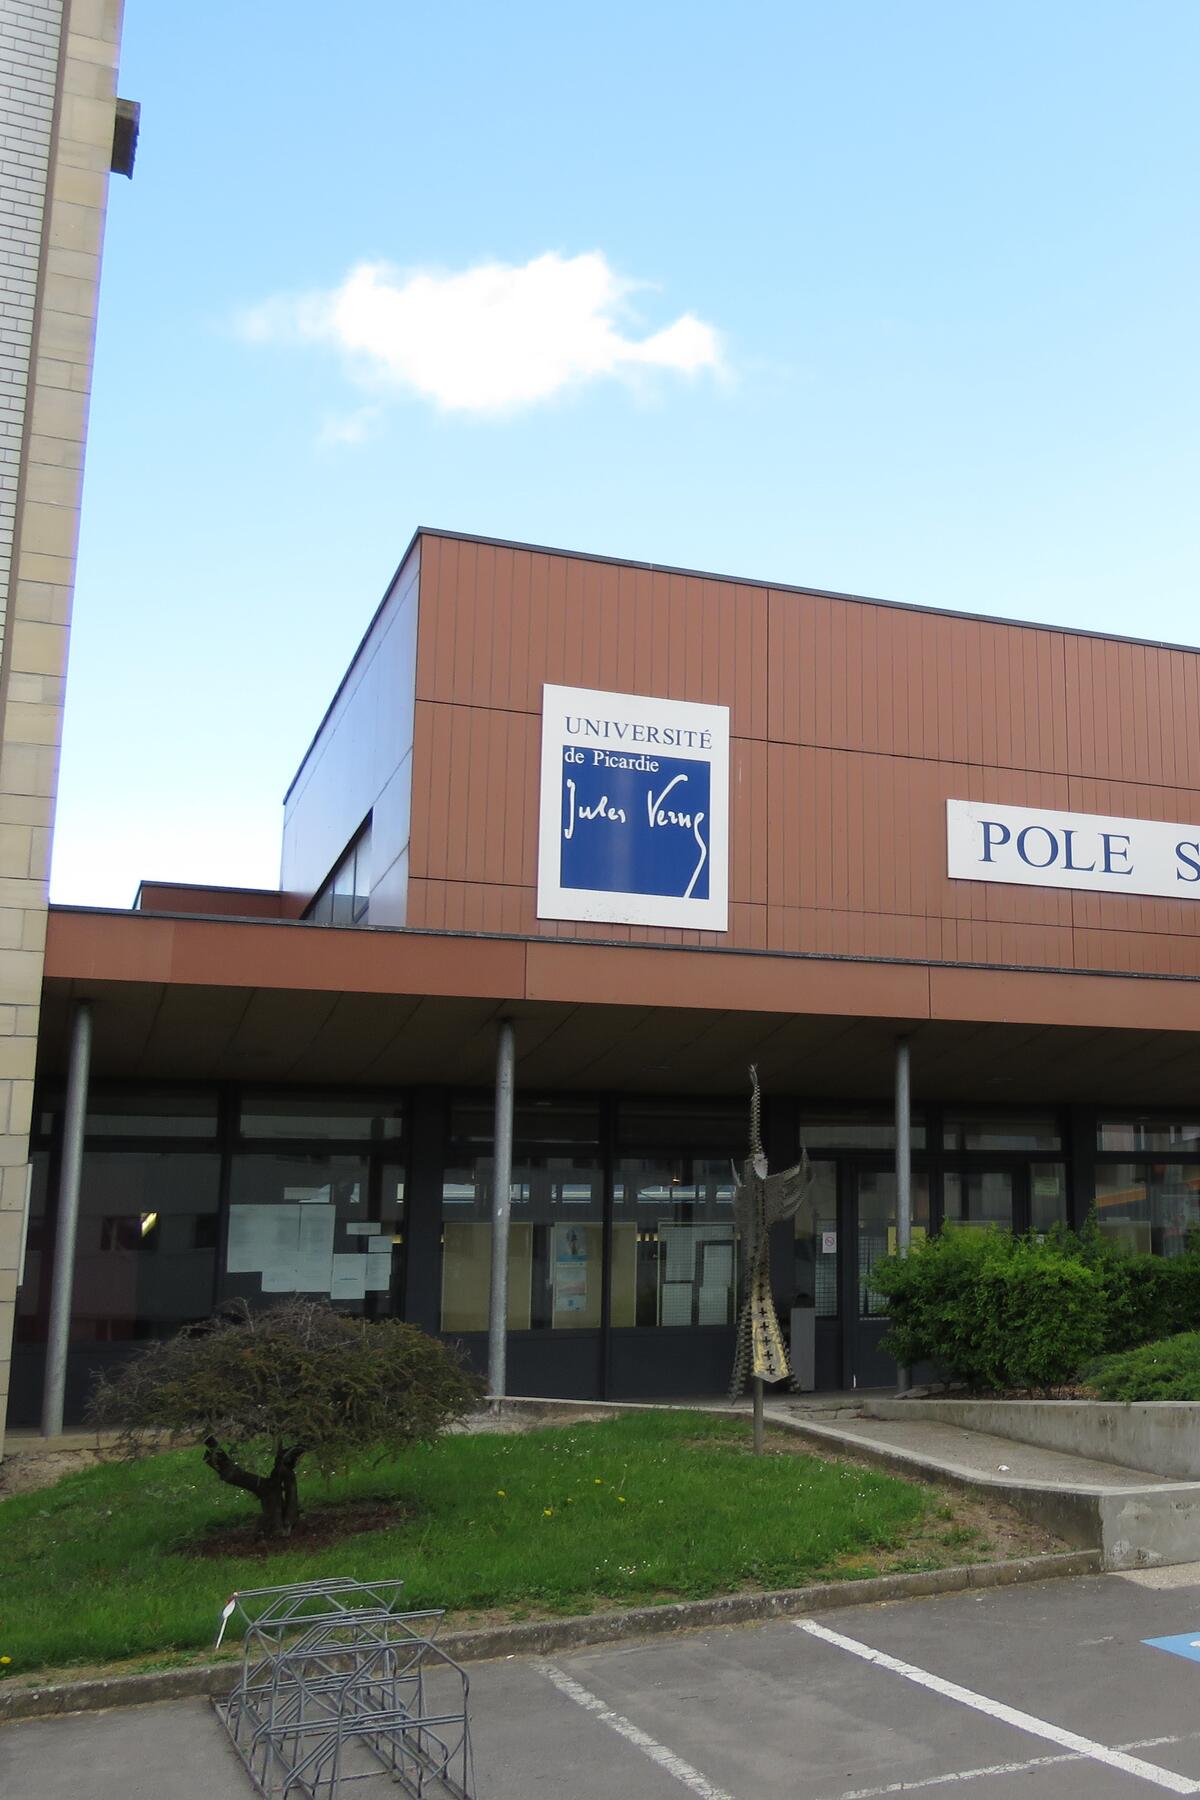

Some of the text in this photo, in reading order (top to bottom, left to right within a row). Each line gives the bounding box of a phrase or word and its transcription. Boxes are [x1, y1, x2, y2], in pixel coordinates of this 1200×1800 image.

[565, 716, 712, 749] UNIVERSITÉ
[564, 747, 660, 773] de Picardie
[564, 778, 626, 840] Jules
[977, 820, 1134, 876] POLE
